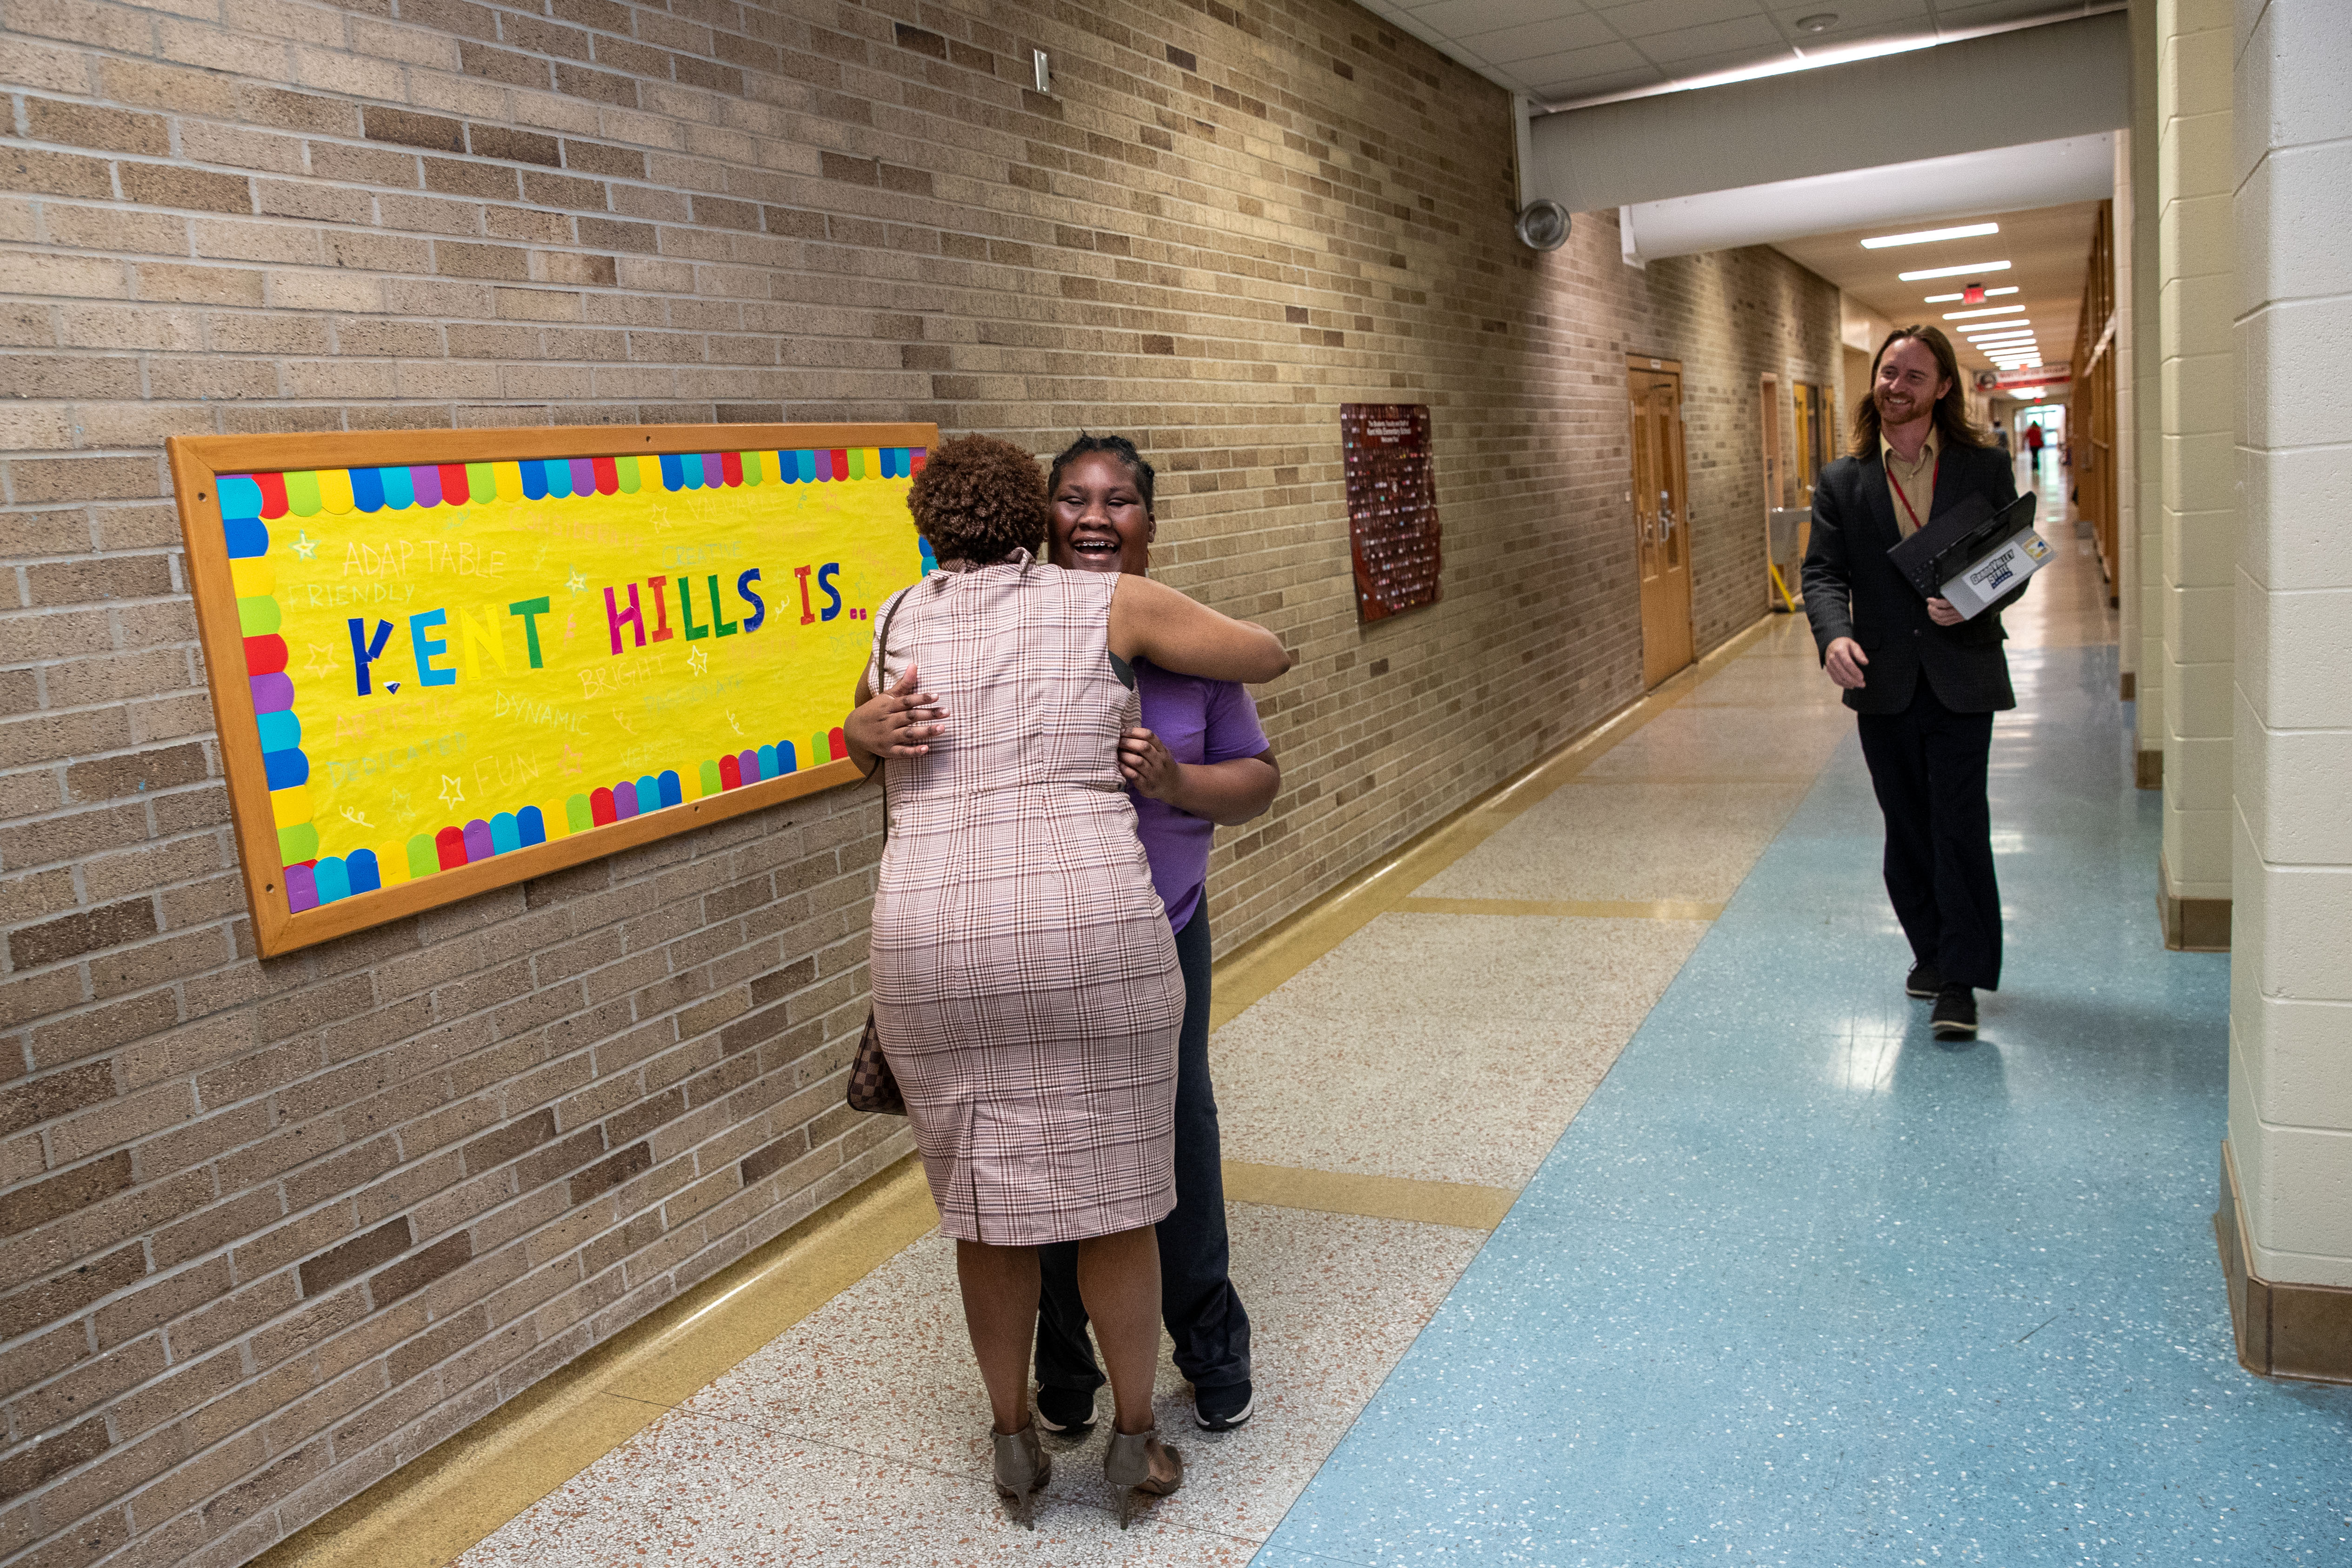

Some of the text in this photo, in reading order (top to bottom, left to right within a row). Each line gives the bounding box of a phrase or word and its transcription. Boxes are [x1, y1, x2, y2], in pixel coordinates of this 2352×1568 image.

[509, 506, 645, 554] CONSIDERATE
[344, 540, 507, 578] ADAPTABLE
[662, 540, 743, 570] CREATIVE
[288, 583, 415, 608] FRIENDLY
[348, 596, 550, 697] KENT
[603, 567, 765, 656] HILLS
[579, 653, 666, 699] BRIGHT
[334, 696, 461, 746] ARTISTIC
[495, 690, 590, 735] DYNAMIC
[326, 731, 468, 789] DEDICATED
[473, 750, 540, 796] FUN
